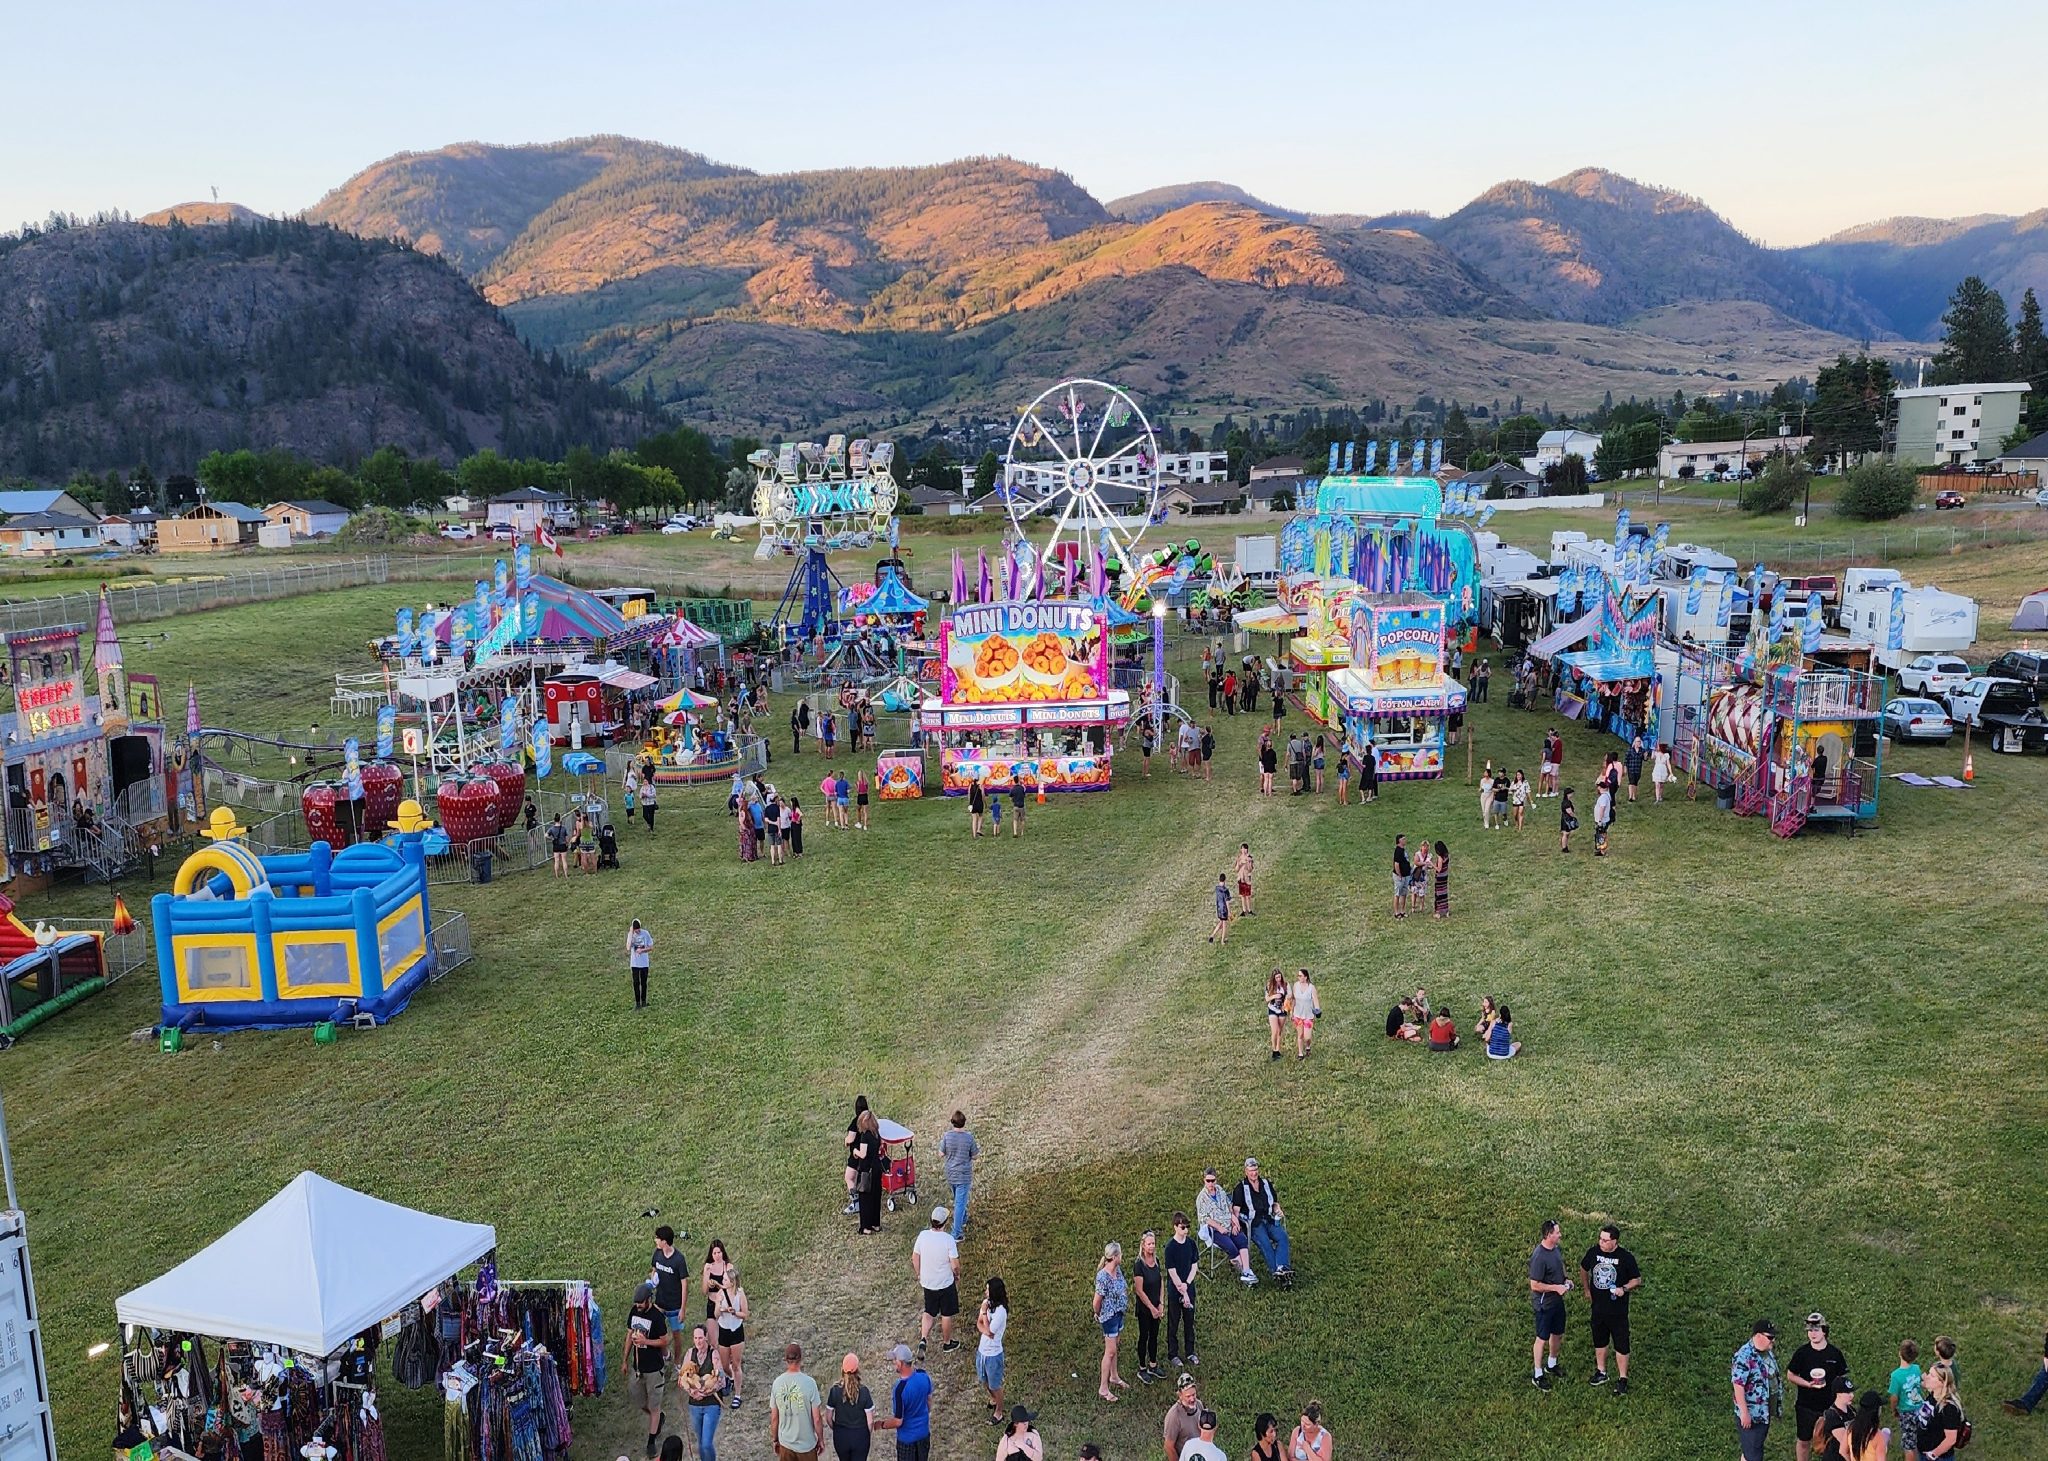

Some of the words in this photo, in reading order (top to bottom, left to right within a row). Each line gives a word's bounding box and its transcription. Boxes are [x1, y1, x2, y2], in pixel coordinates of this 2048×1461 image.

[954, 608, 1003, 637] MINI
[1008, 606, 1093, 631] DONUTS
[1380, 629, 1439, 647] POPCORN
[1380, 700, 1413, 709] COTTON
[1414, 699, 1441, 708] CANDY
